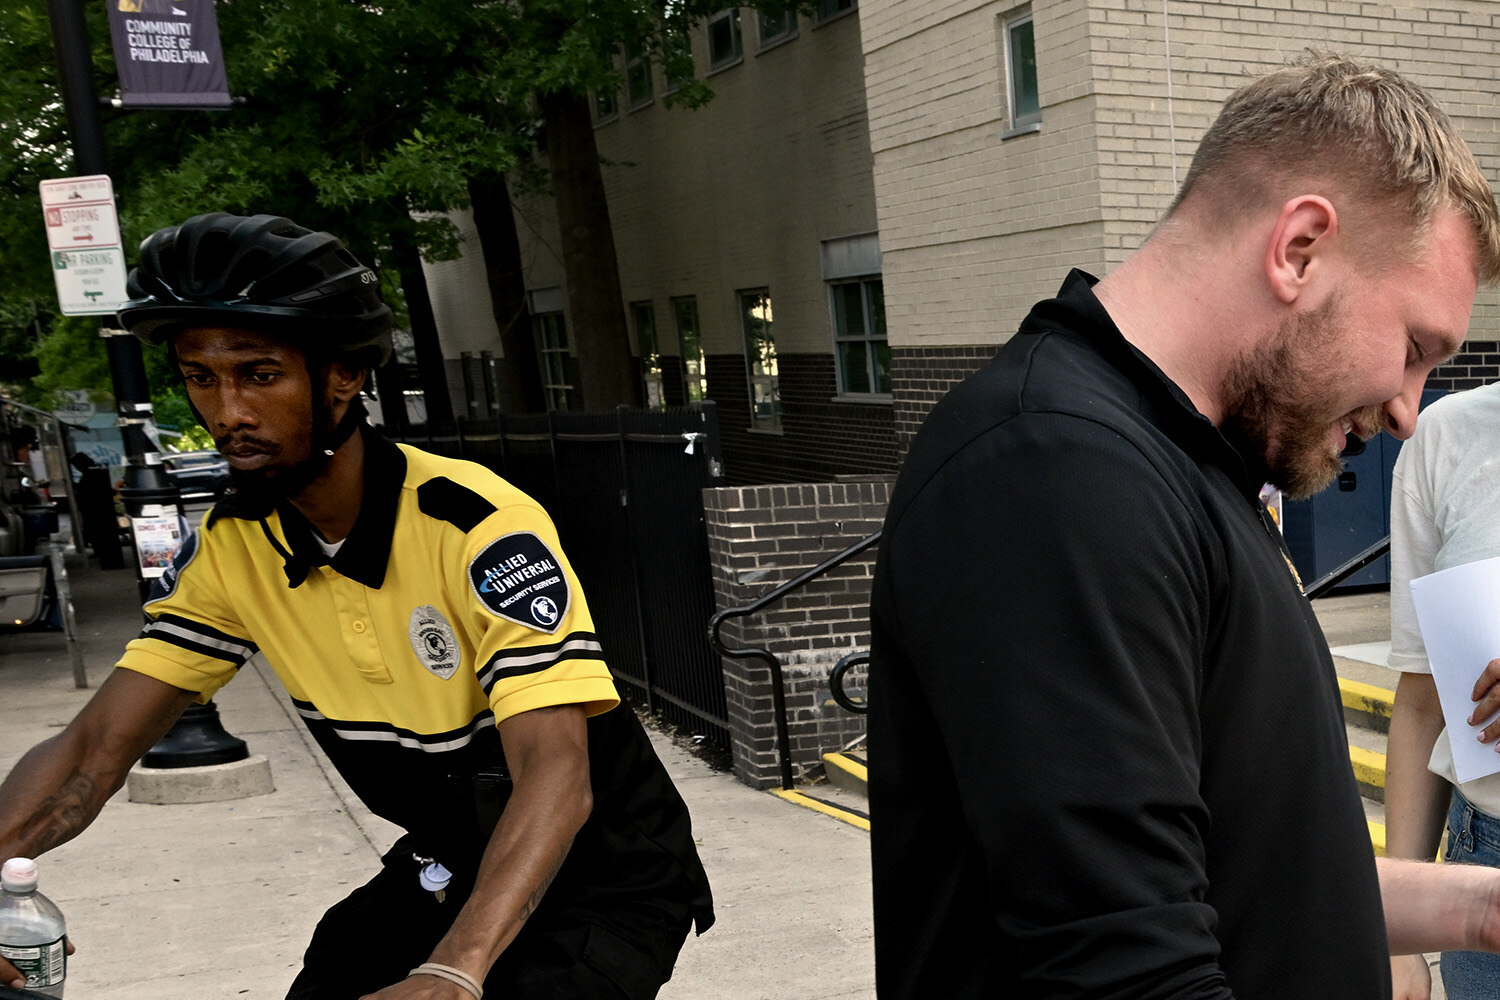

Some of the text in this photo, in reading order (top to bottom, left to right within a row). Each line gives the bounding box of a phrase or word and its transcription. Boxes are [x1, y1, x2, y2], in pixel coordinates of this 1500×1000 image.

[125, 19, 192, 36] COMMUNITY
[128, 33, 192, 49] COLLEGE OF
[129, 47, 210, 64] PHILADELPHIA
[63, 209, 100, 224] STOPPING
[79, 252, 113, 266] PARKING
[484, 553, 528, 582] ALLIED
[491, 559, 556, 594] UNIVERSAL
[499, 575, 561, 609] SECURITY SERVICES
